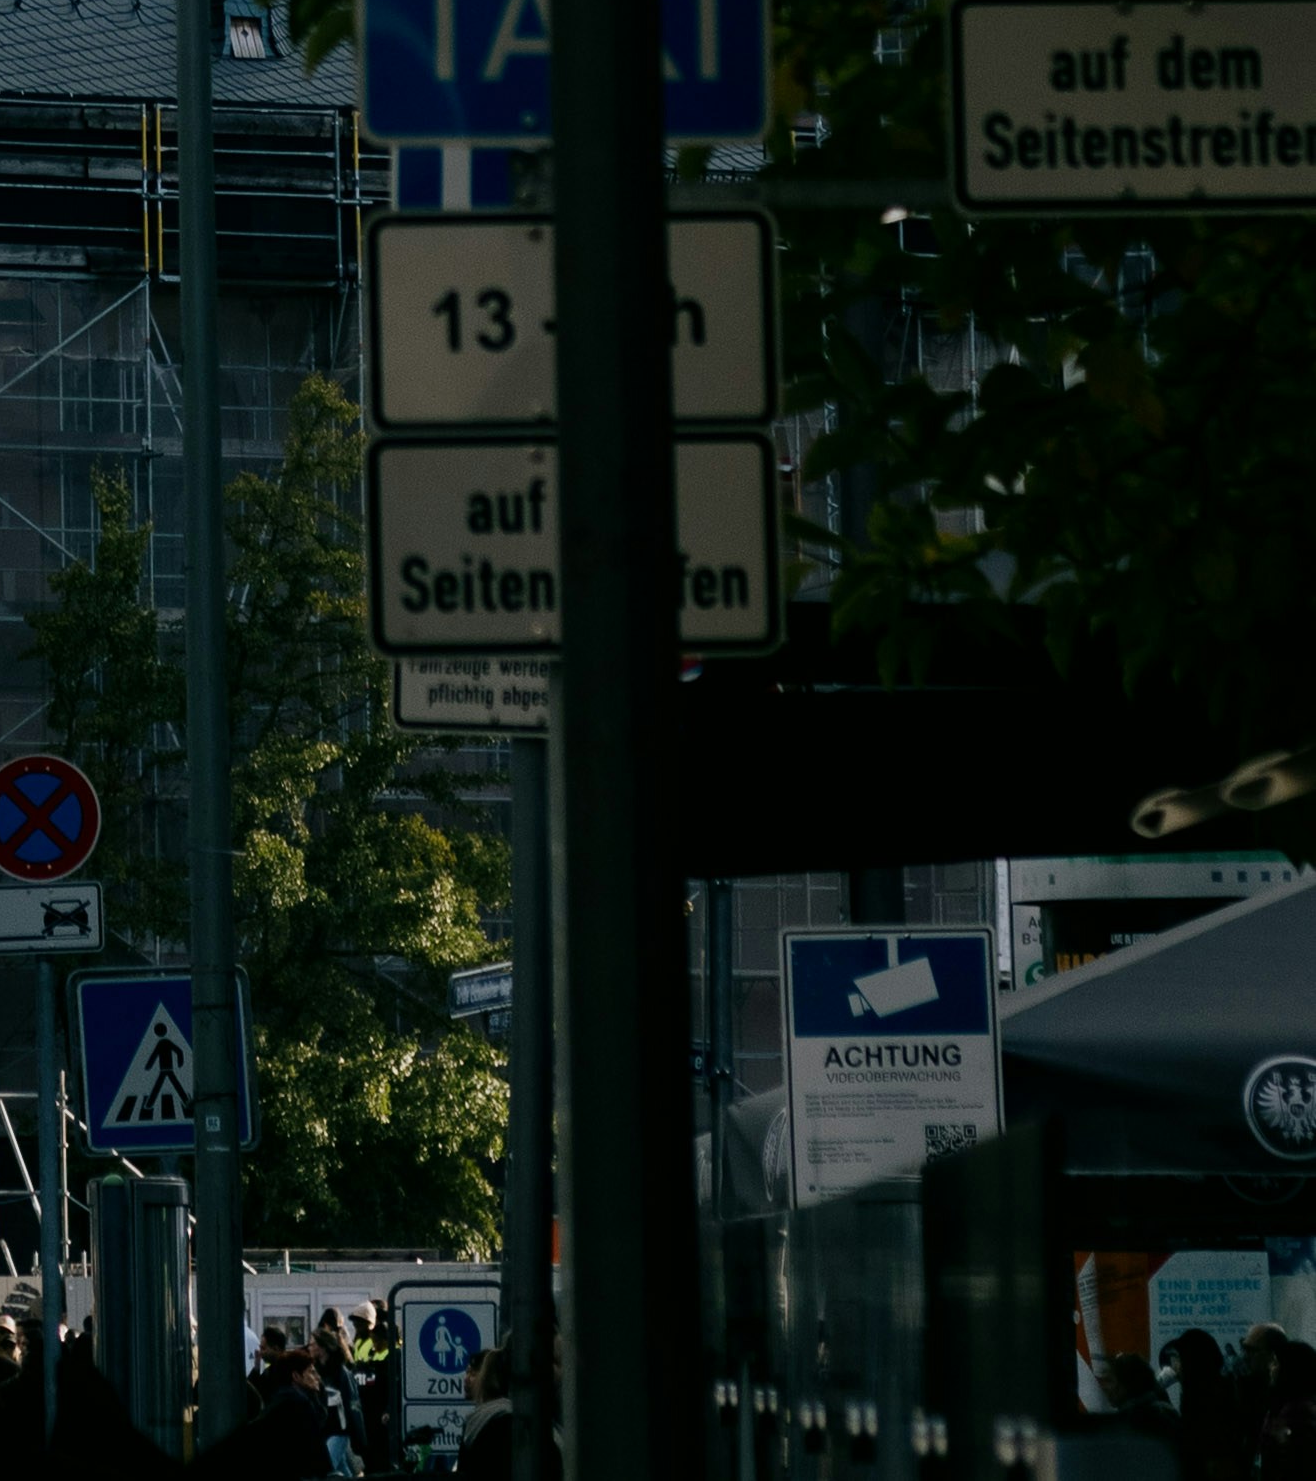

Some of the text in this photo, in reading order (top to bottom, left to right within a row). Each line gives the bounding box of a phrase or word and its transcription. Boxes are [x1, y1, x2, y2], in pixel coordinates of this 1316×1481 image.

[1051, 35, 1260, 90] auf dem
[434, 289, 514, 352] 13
[468, 479, 547, 533] auf
[500, 660, 550, 676] werde
[429, 683, 549, 711] pflichtig abges
[824, 1044, 962, 1069] ACHTUNG
[826, 1069, 961, 1084] VIDEOÜBERWACHUNG
[1158, 1279, 1261, 1290] EINE BESSERE
[1158, 1305, 1192, 1315] DEIN
[428, 1378, 463, 1395] ZON
